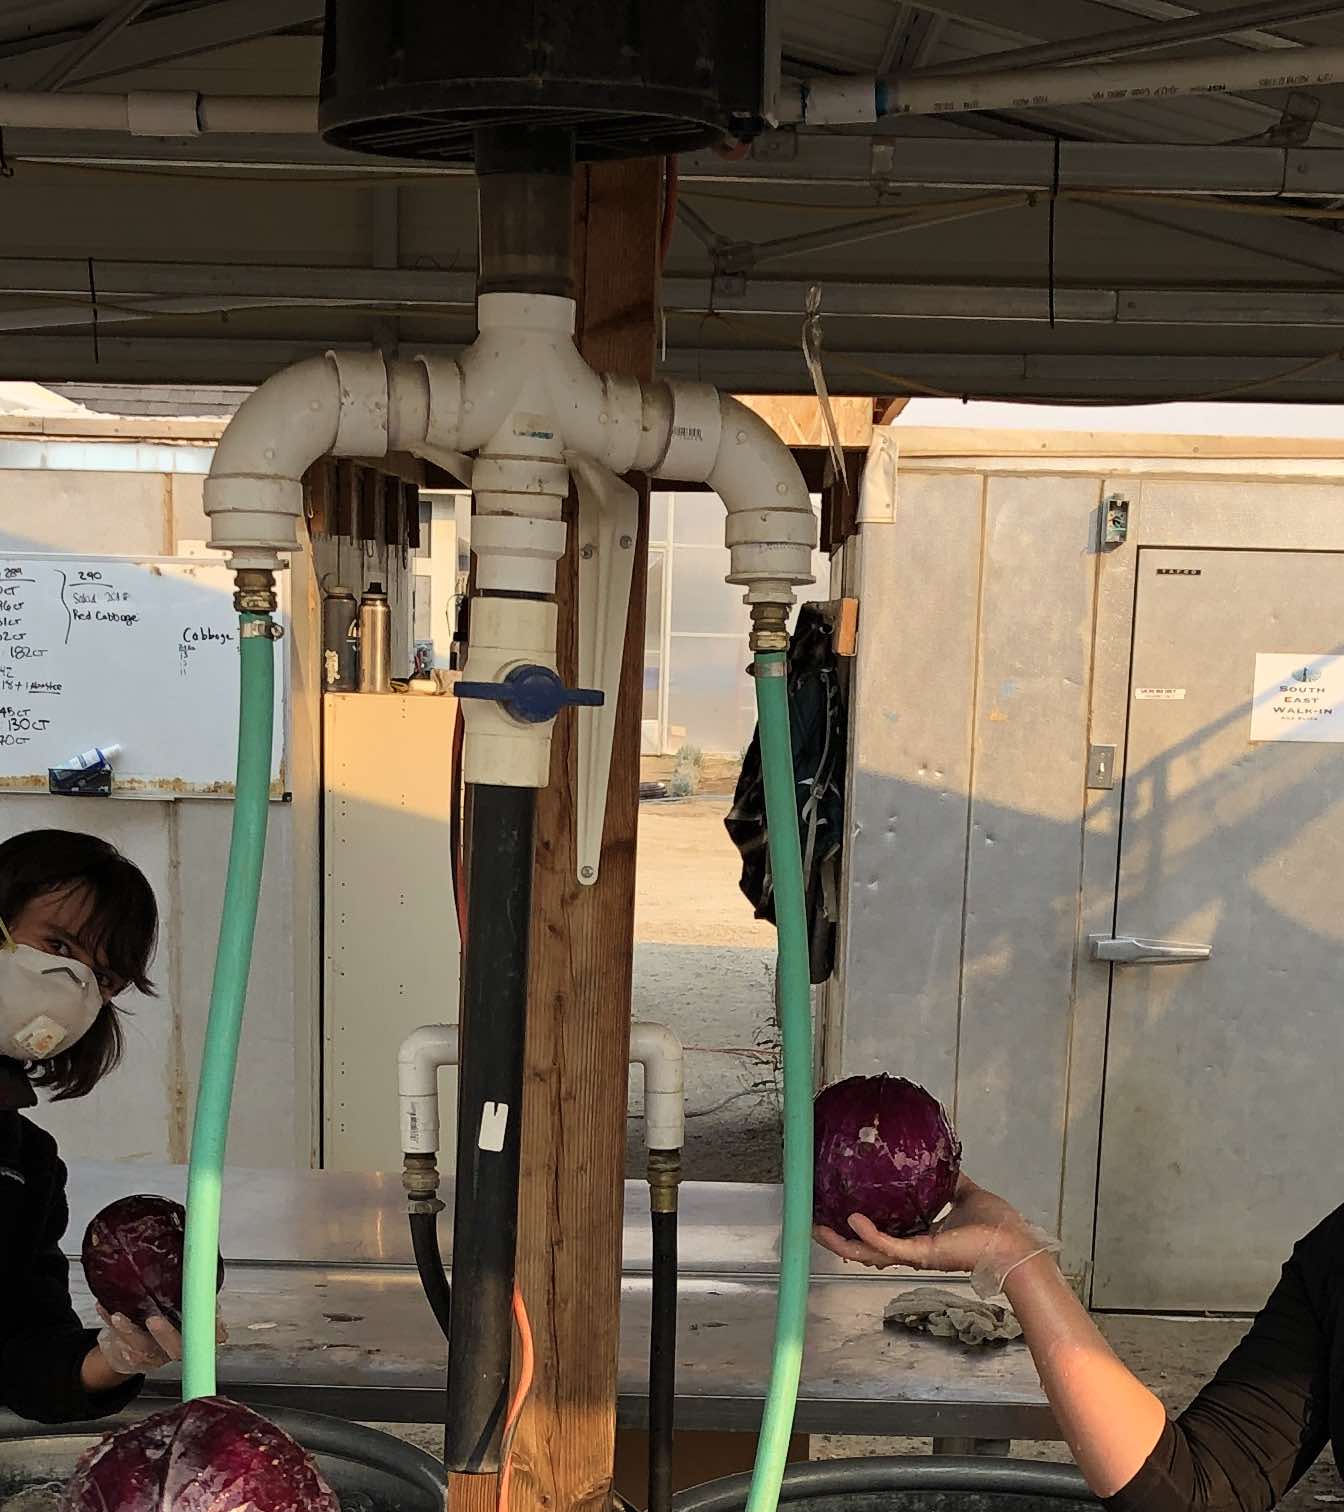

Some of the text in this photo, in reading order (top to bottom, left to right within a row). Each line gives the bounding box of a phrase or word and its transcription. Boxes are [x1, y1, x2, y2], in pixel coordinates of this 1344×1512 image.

[79, 571, 102, 581] 290
[73, 608, 140, 626] Red Cabbage
[183, 627, 234, 645] Cabbage
